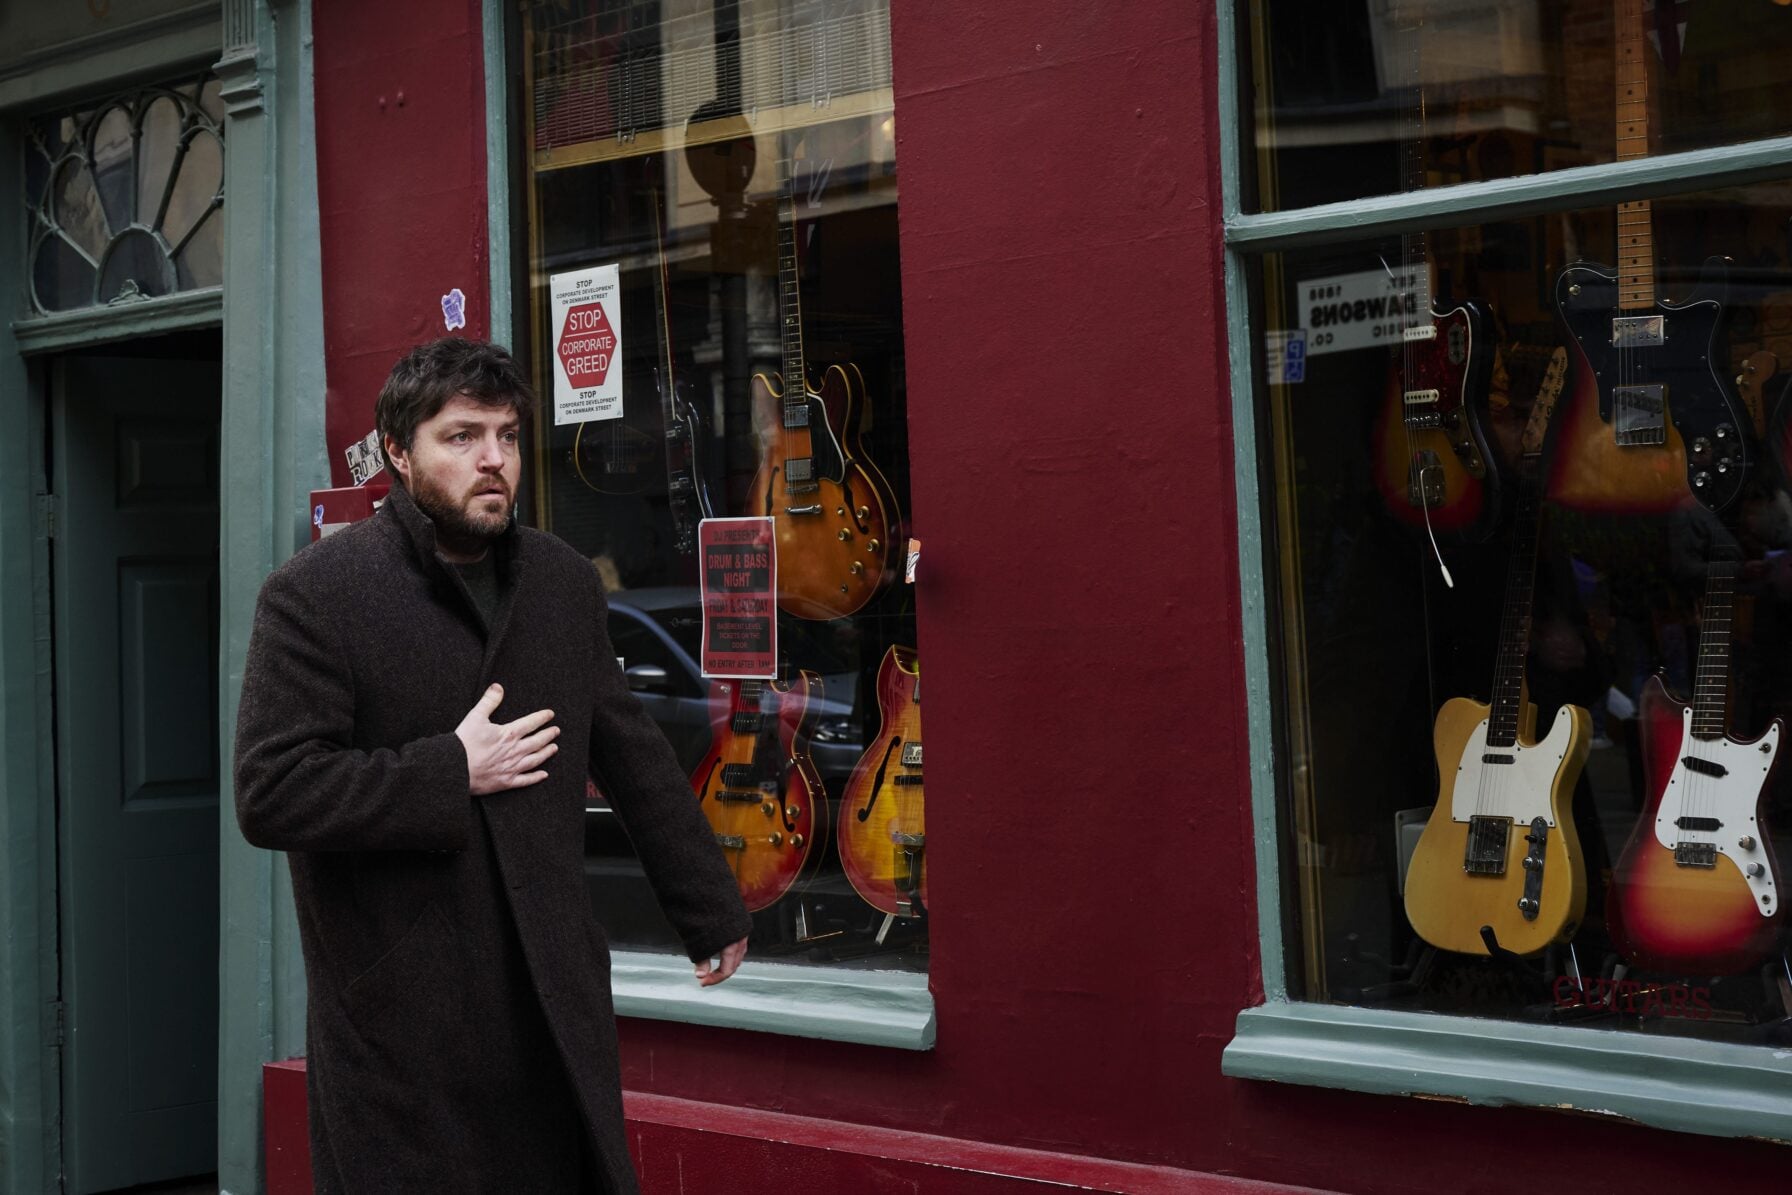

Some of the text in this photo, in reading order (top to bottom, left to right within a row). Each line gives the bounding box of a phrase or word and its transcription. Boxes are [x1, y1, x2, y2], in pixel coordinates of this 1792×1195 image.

[556, 285, 614, 299] CORPORATE DEVELOPMENT
[576, 279, 593, 289] STOP
[569, 296, 590, 304] DENMARK
[569, 309, 601, 331] STOP
[561, 336, 612, 356] CORPORATE
[566, 353, 608, 376] GREED
[560, 397, 617, 409] CORPORATE DEVELOPMENT
[579, 391, 596, 399] STOP
[351, 449, 382, 485] ROK
[708, 552, 767, 569] DRUM & BASS
[723, 572, 751, 588] NIGHT
[708, 660, 717, 669] NO
[717, 660, 735, 669] ENTRY
[737, 660, 754, 669] AFTER
[1552, 975, 1713, 1020] GUITARS
